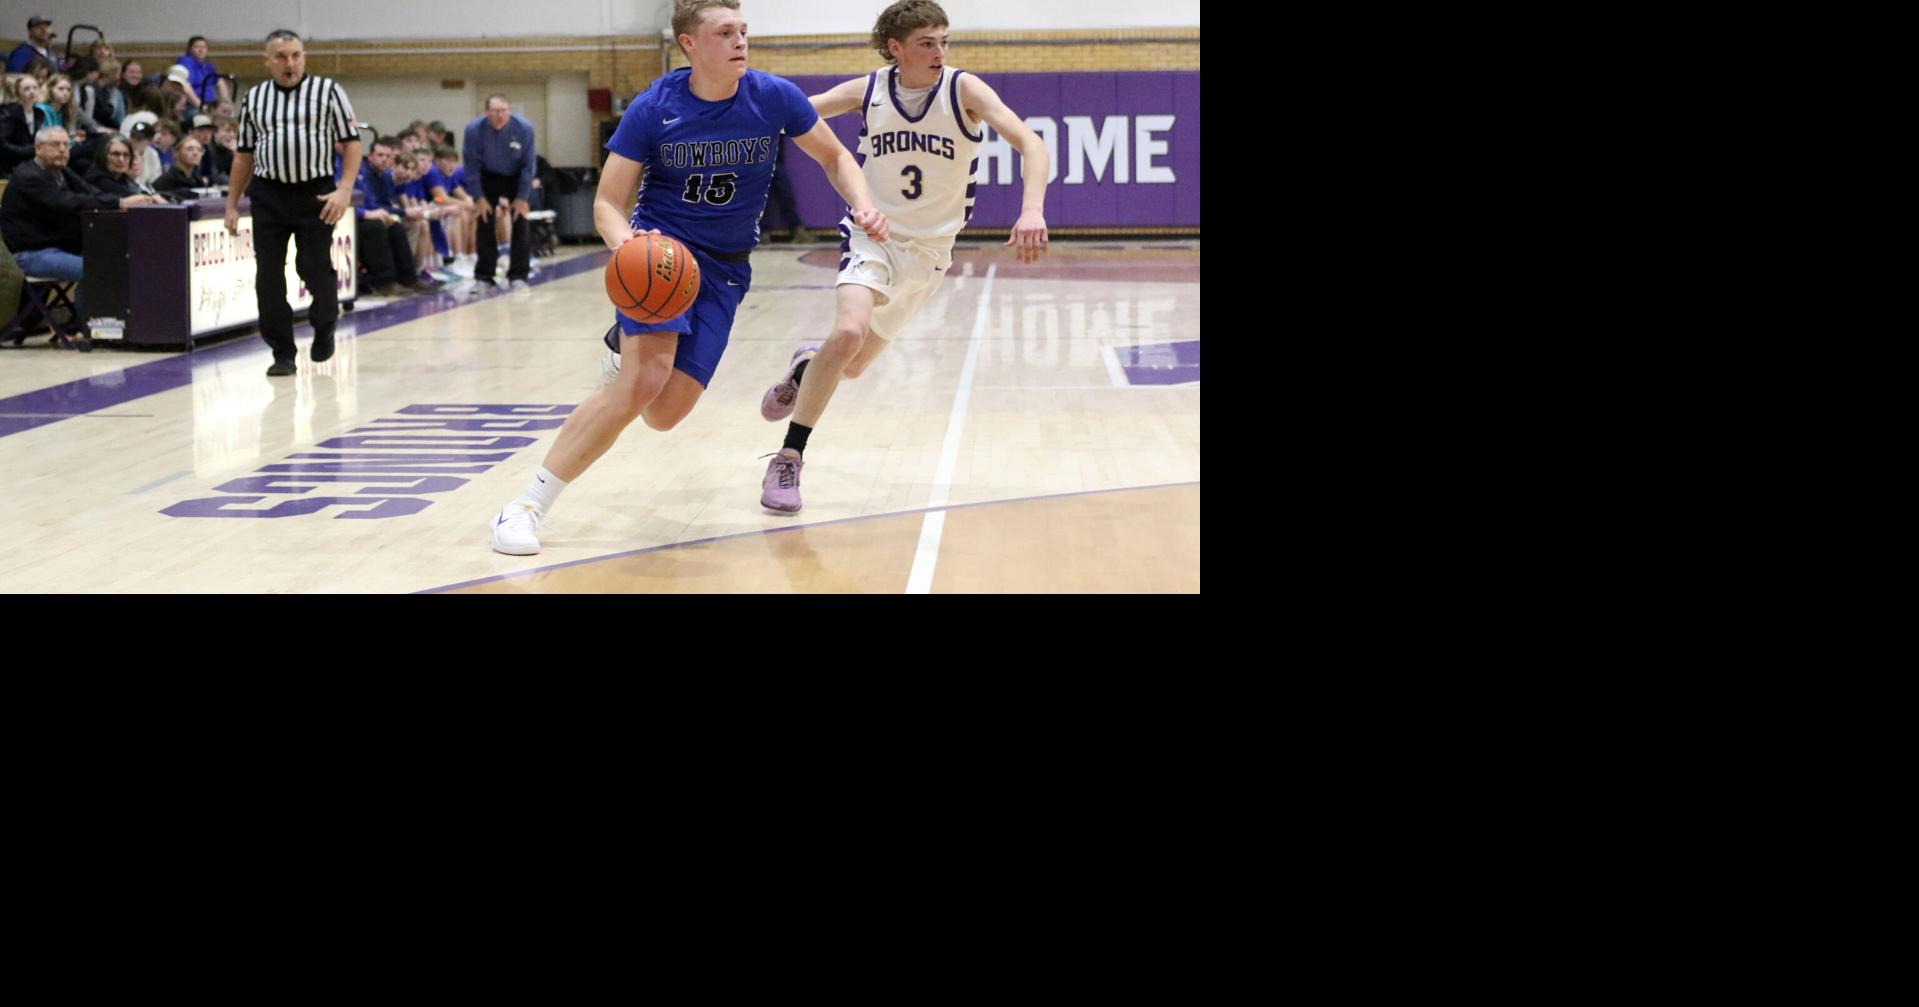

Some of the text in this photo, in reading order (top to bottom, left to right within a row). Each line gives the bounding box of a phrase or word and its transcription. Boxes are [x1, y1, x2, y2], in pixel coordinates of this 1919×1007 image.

[660, 136, 771, 168] COWBOYS
[871, 130, 955, 161] BRONCS
[975, 114, 1177, 186] HOME
[682, 172, 739, 206] 15
[900, 164, 923, 201] 3
[193, 231, 225, 267] BELLE
[157, 403, 579, 519] BRONCS
